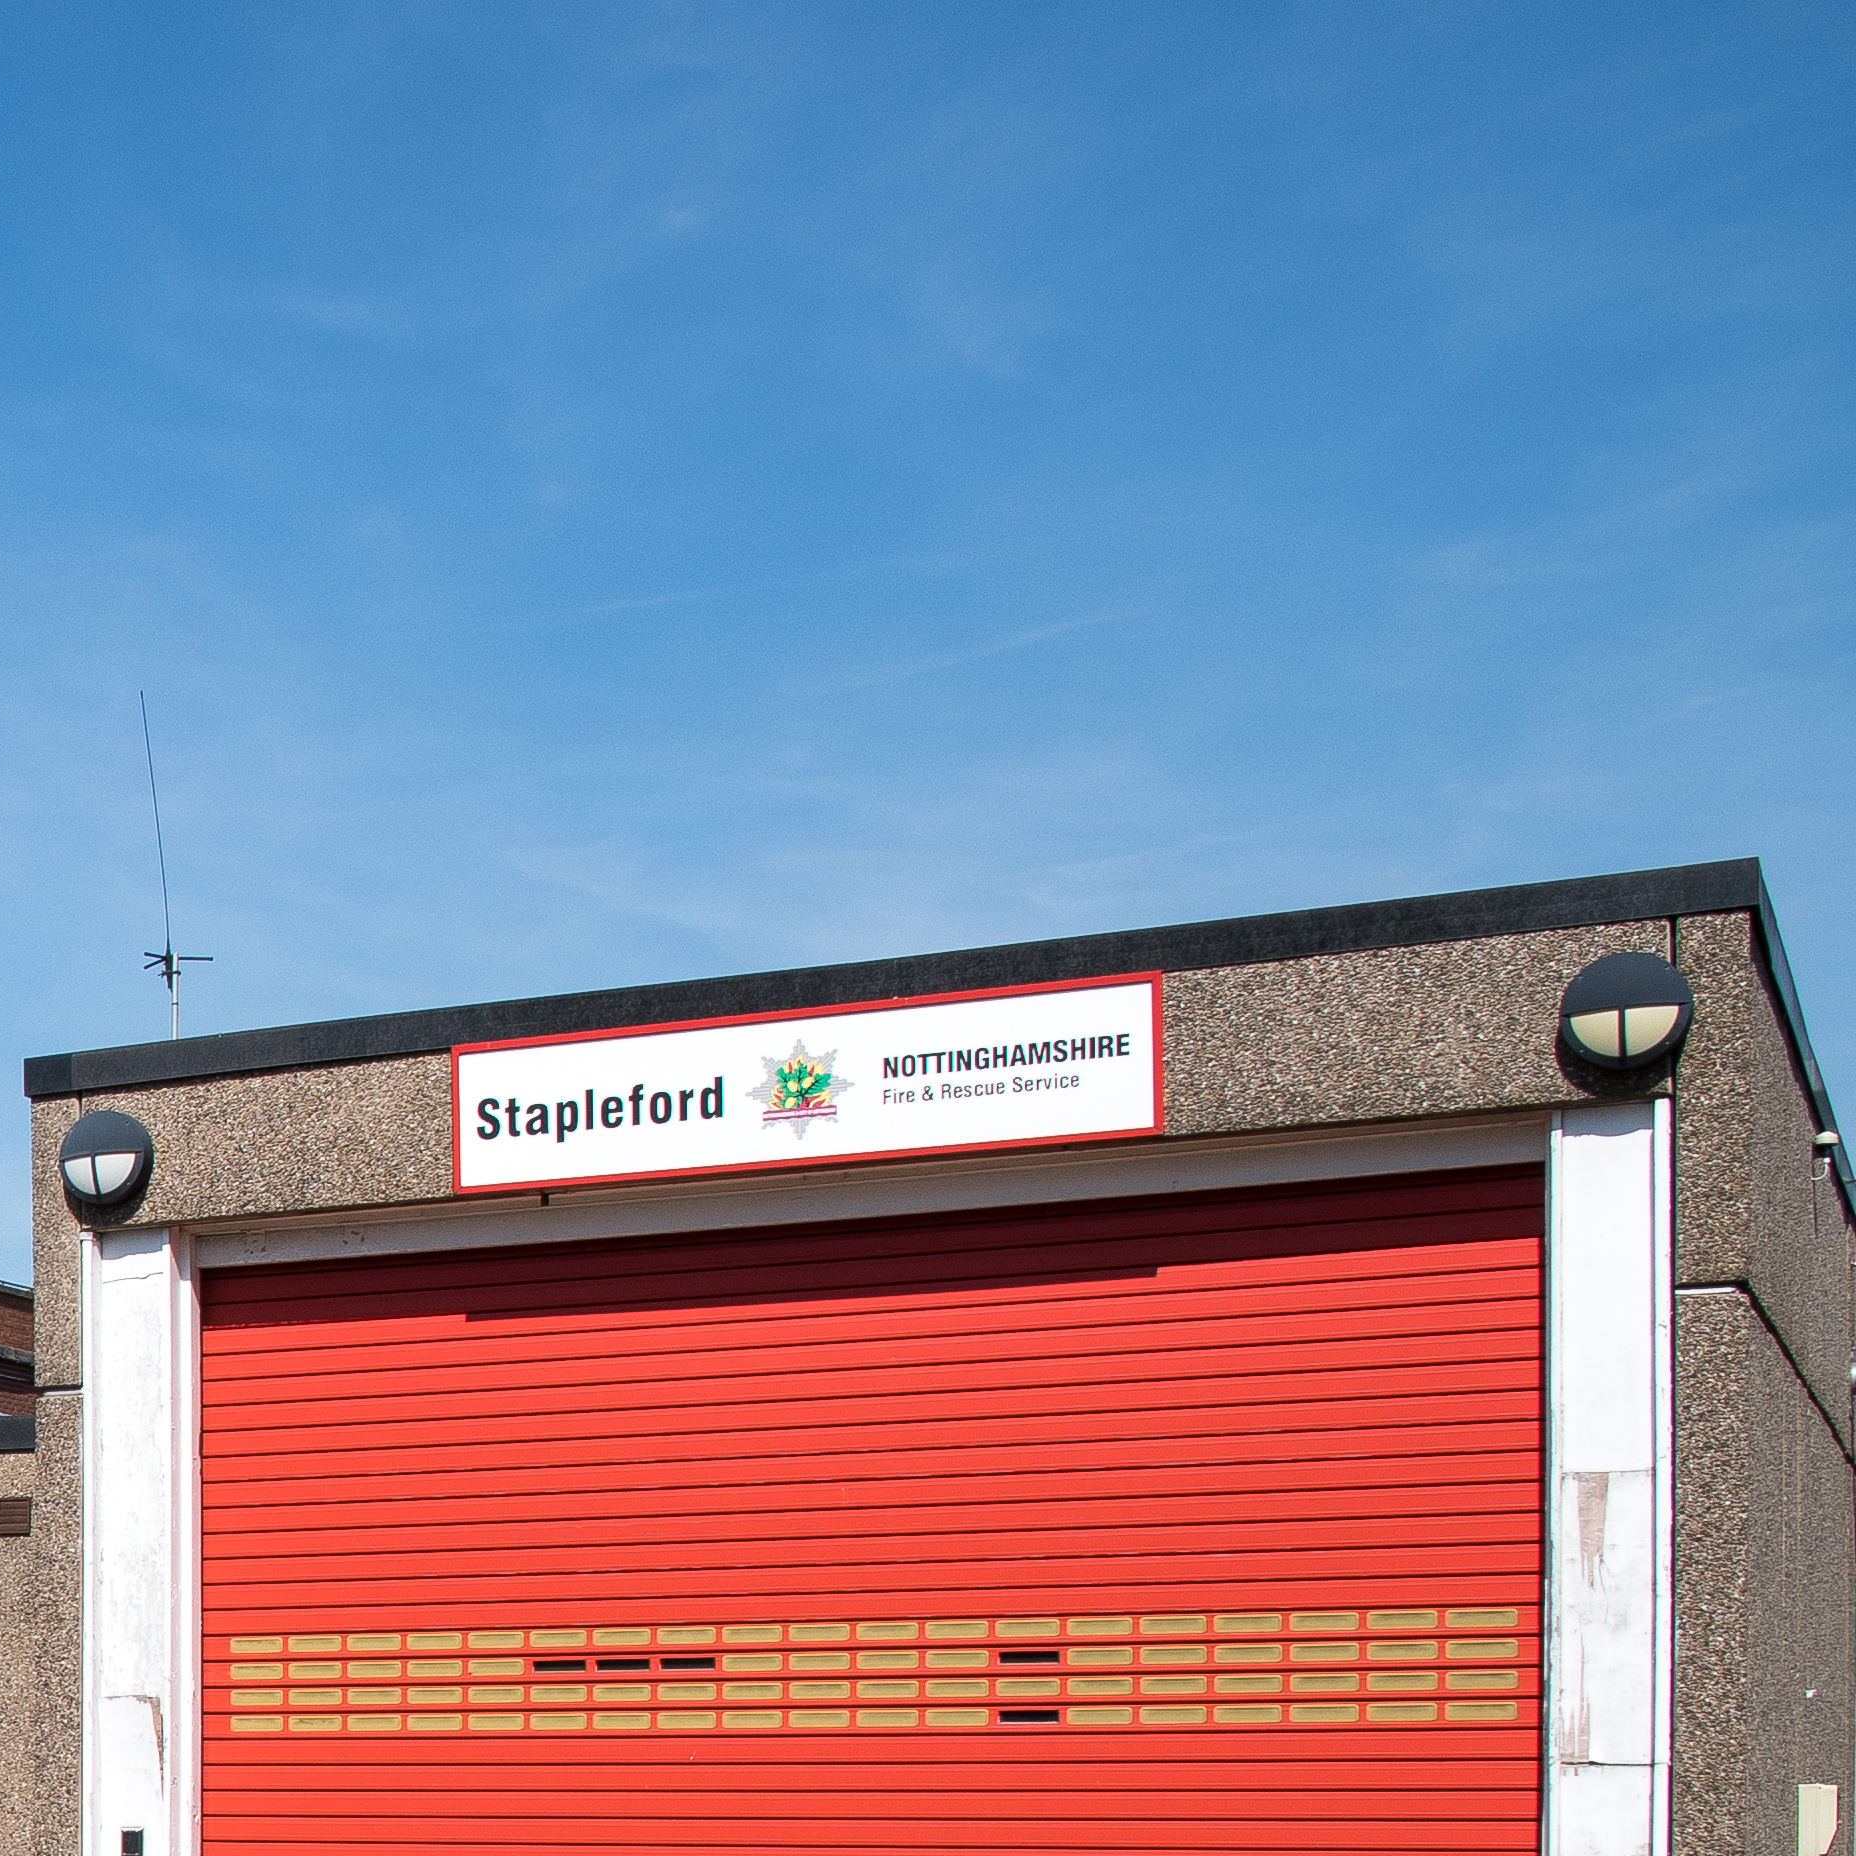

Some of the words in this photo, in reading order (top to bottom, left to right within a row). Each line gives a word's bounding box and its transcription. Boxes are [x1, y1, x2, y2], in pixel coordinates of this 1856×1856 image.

[882, 1033, 1130, 1079] NOTTINGHAMSHIRE
[476, 1075, 724, 1143] Stapleford
[882, 1089, 916, 1105] Fire
[921, 1085, 934, 1101] &
[940, 1081, 1006, 1100] Rescue
[1012, 1073, 1081, 1093] Service
